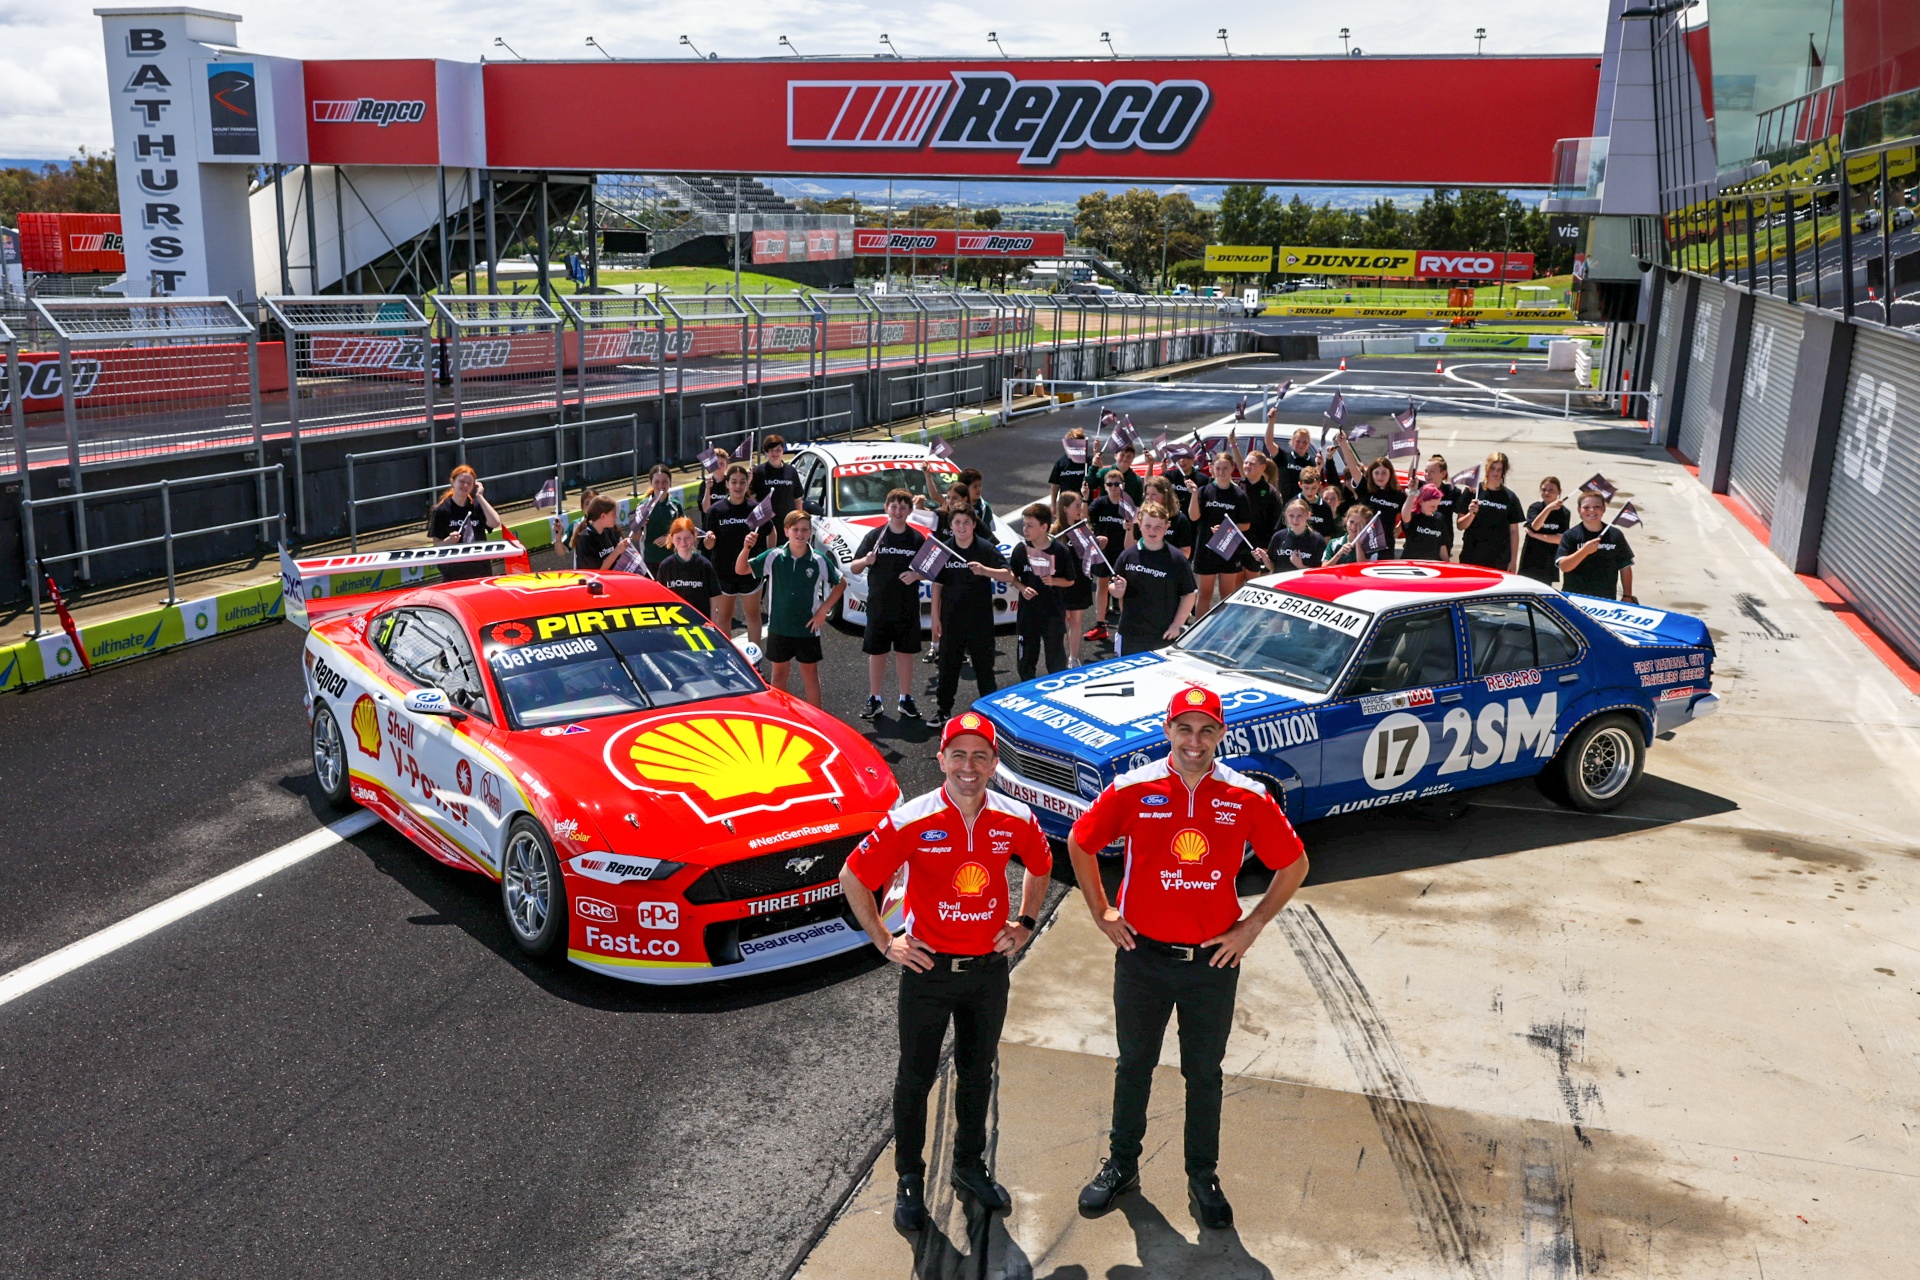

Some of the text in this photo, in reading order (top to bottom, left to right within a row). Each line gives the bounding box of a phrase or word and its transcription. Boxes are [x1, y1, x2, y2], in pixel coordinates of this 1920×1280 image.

[356, 98, 426, 127] Repco
[931, 71, 1209, 165] Repco
[126, 28, 187, 292] BATHURST
[889, 234, 937, 251] Repco
[986, 235, 1034, 252] Repco
[1217, 254, 1269, 262] DUNLOP
[1302, 254, 1409, 269] DUNLOP
[1420, 256, 1495, 273] RYCO
[1295, 307, 1335, 315] DUNLOP
[1362, 308, 1407, 316] DUNLOP
[771, 327, 819, 351] Repco
[1843, 373, 1897, 495] 33
[1125, 563, 1167, 578] LifeChanger
[1372, 568, 1429, 577] 17
[335, 576, 373, 594] ultimate
[225, 602, 268, 622] ultimate
[1236, 589, 1361, 630] MOSS BRABHAM
[1580, 605, 1654, 627] OODYEAR
[536, 606, 689, 640] PIRTEK
[92, 632, 144, 658] ultimate
[674, 626, 715, 652] 11
[1633, 653, 1705, 674] FIRST NATIONAL CITY
[312, 656, 348, 699] Repco
[1034, 656, 1160, 691] REPCO
[1484, 669, 1542, 692] RECARO
[1640, 670, 1679, 687] TRAVELERS
[1084, 681, 1135, 697] 17
[1361, 689, 1433, 705] HARDIE 1000
[414, 702, 445, 710] Doric
[1363, 703, 1392, 714] FERODO
[387, 710, 415, 750] Shell
[992, 693, 1037, 713] 2SM
[1063, 724, 1122, 749] UNION
[1251, 711, 1319, 753] UNION
[1437, 691, 1558, 776] 2SM
[487, 743, 513, 762] DUNLOP
[1374, 725, 1420, 780] 17
[389, 740, 469, 827] V-Power
[1001, 777, 1038, 804] SMASH
[1419, 786, 1455, 798] WHEELS
[1423, 783, 1450, 793] ALLOY
[1145, 796, 1165, 804] Ford
[1219, 801, 1242, 810] PIRTEK
[1325, 789, 1418, 818] AUNGER
[1214, 812, 1236, 822] DXC
[554, 819, 578, 838] Instyle
[570, 831, 591, 842] Solar
[748, 822, 840, 850] #NextGenRanger
[925, 831, 944, 839] Ford
[992, 841, 1010, 851] DXC
[605, 861, 653, 877] Repco
[1160, 869, 1182, 879] Shell
[1161, 879, 1217, 890] V-Power
[748, 882, 845, 915] THREE THREE
[938, 901, 961, 911] Shell
[579, 901, 614, 920] CRC
[640, 905, 678, 926] PPG
[939, 910, 994, 922] V-Power
[586, 925, 680, 956] Fast.co
[740, 920, 846, 956] Beaurepaires
